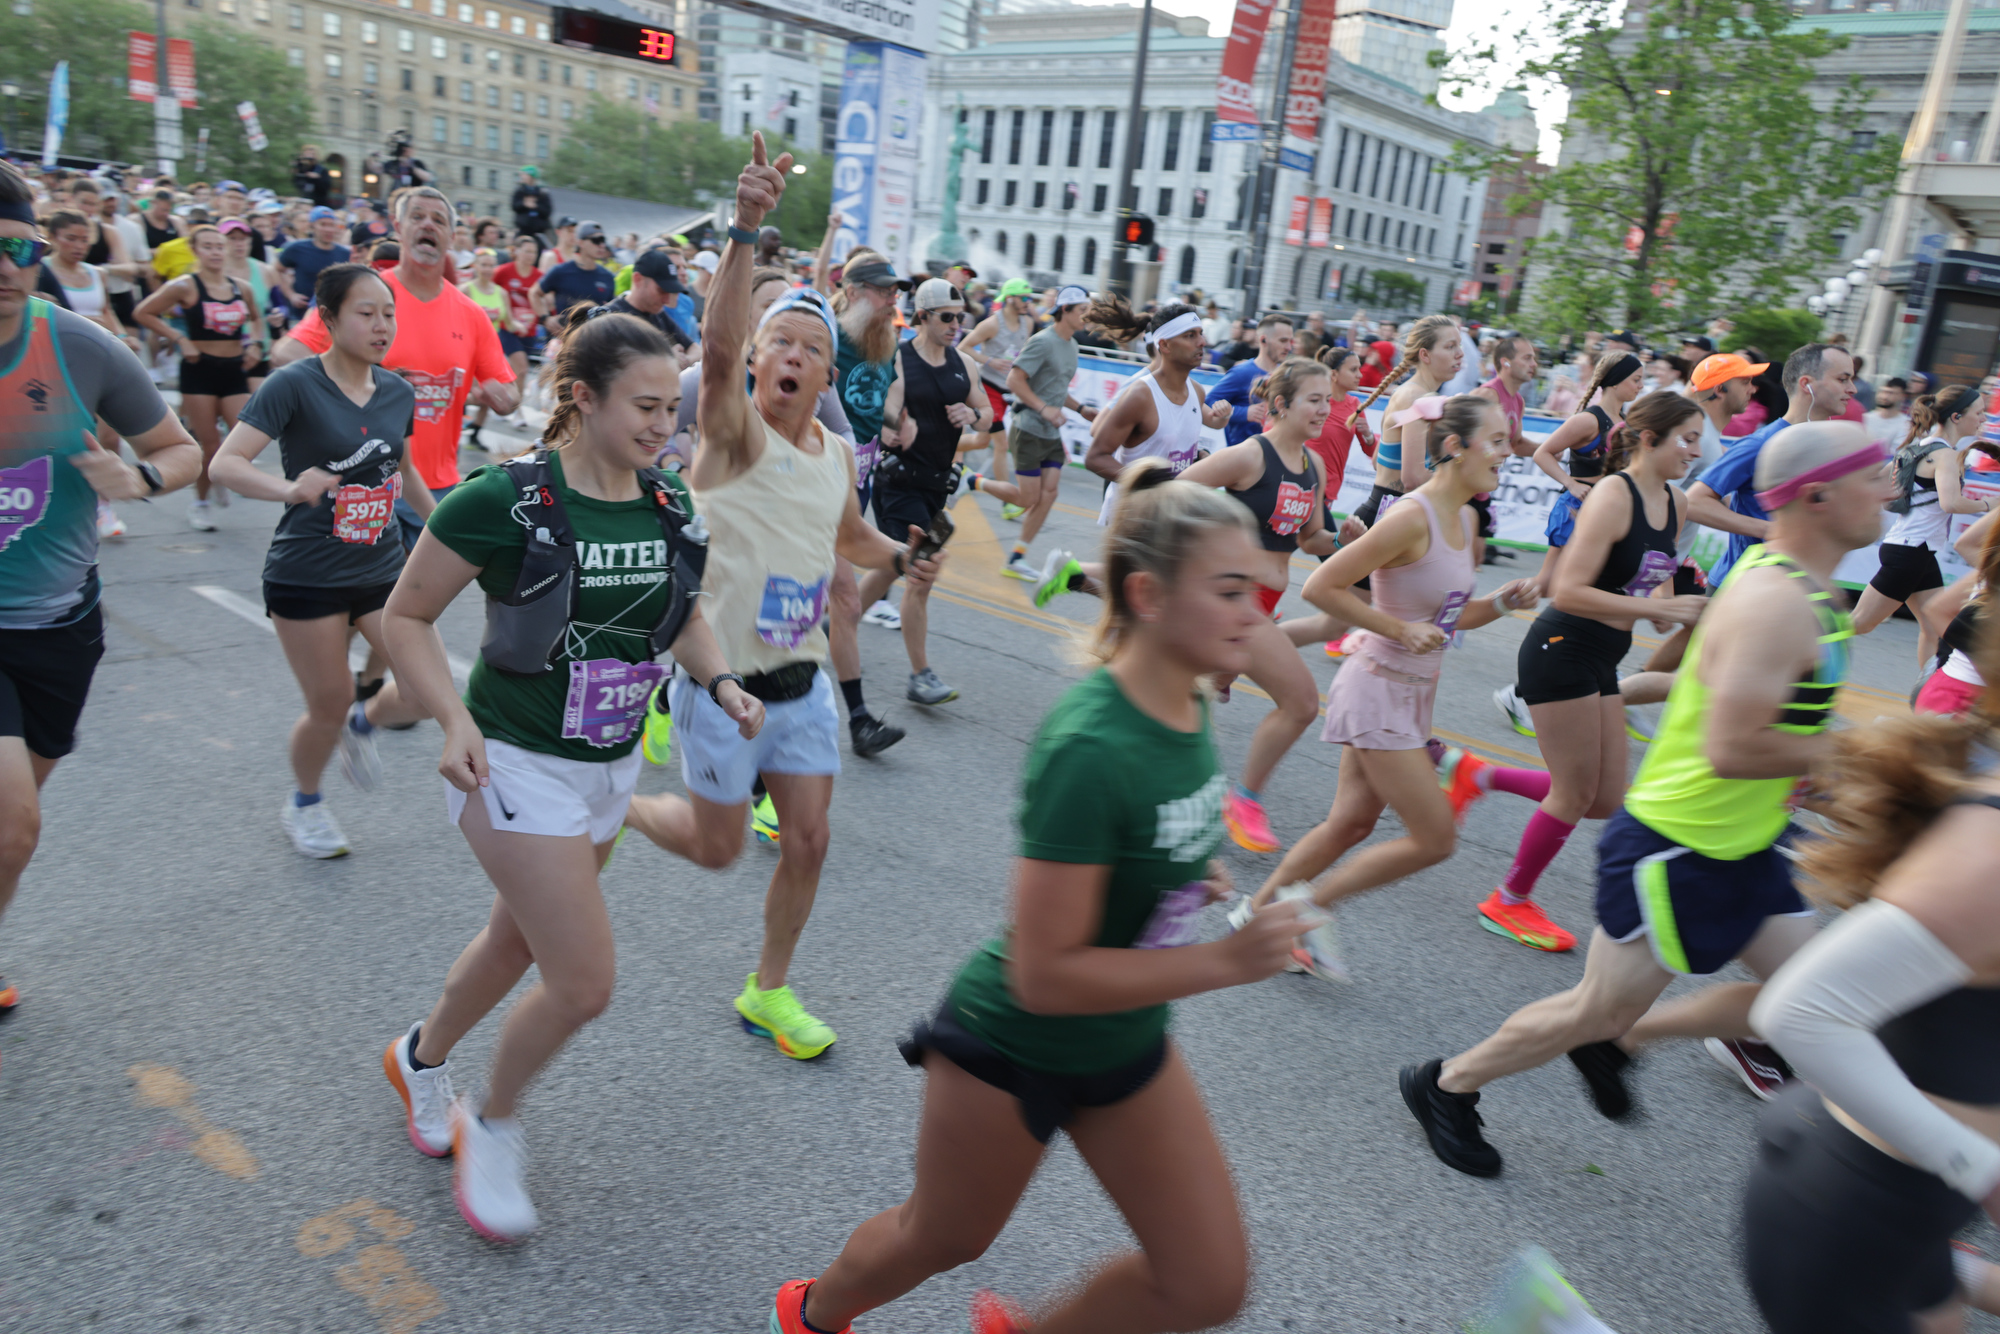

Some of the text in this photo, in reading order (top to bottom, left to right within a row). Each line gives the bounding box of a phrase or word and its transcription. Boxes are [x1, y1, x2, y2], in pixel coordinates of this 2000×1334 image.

[822, 0, 914, 31] arathon
[345, 499, 388, 521] 5975
[1281, 498, 1311, 518] 5881
[520, 572, 559, 597] SALOMON
[595, 679, 653, 711] 2199
